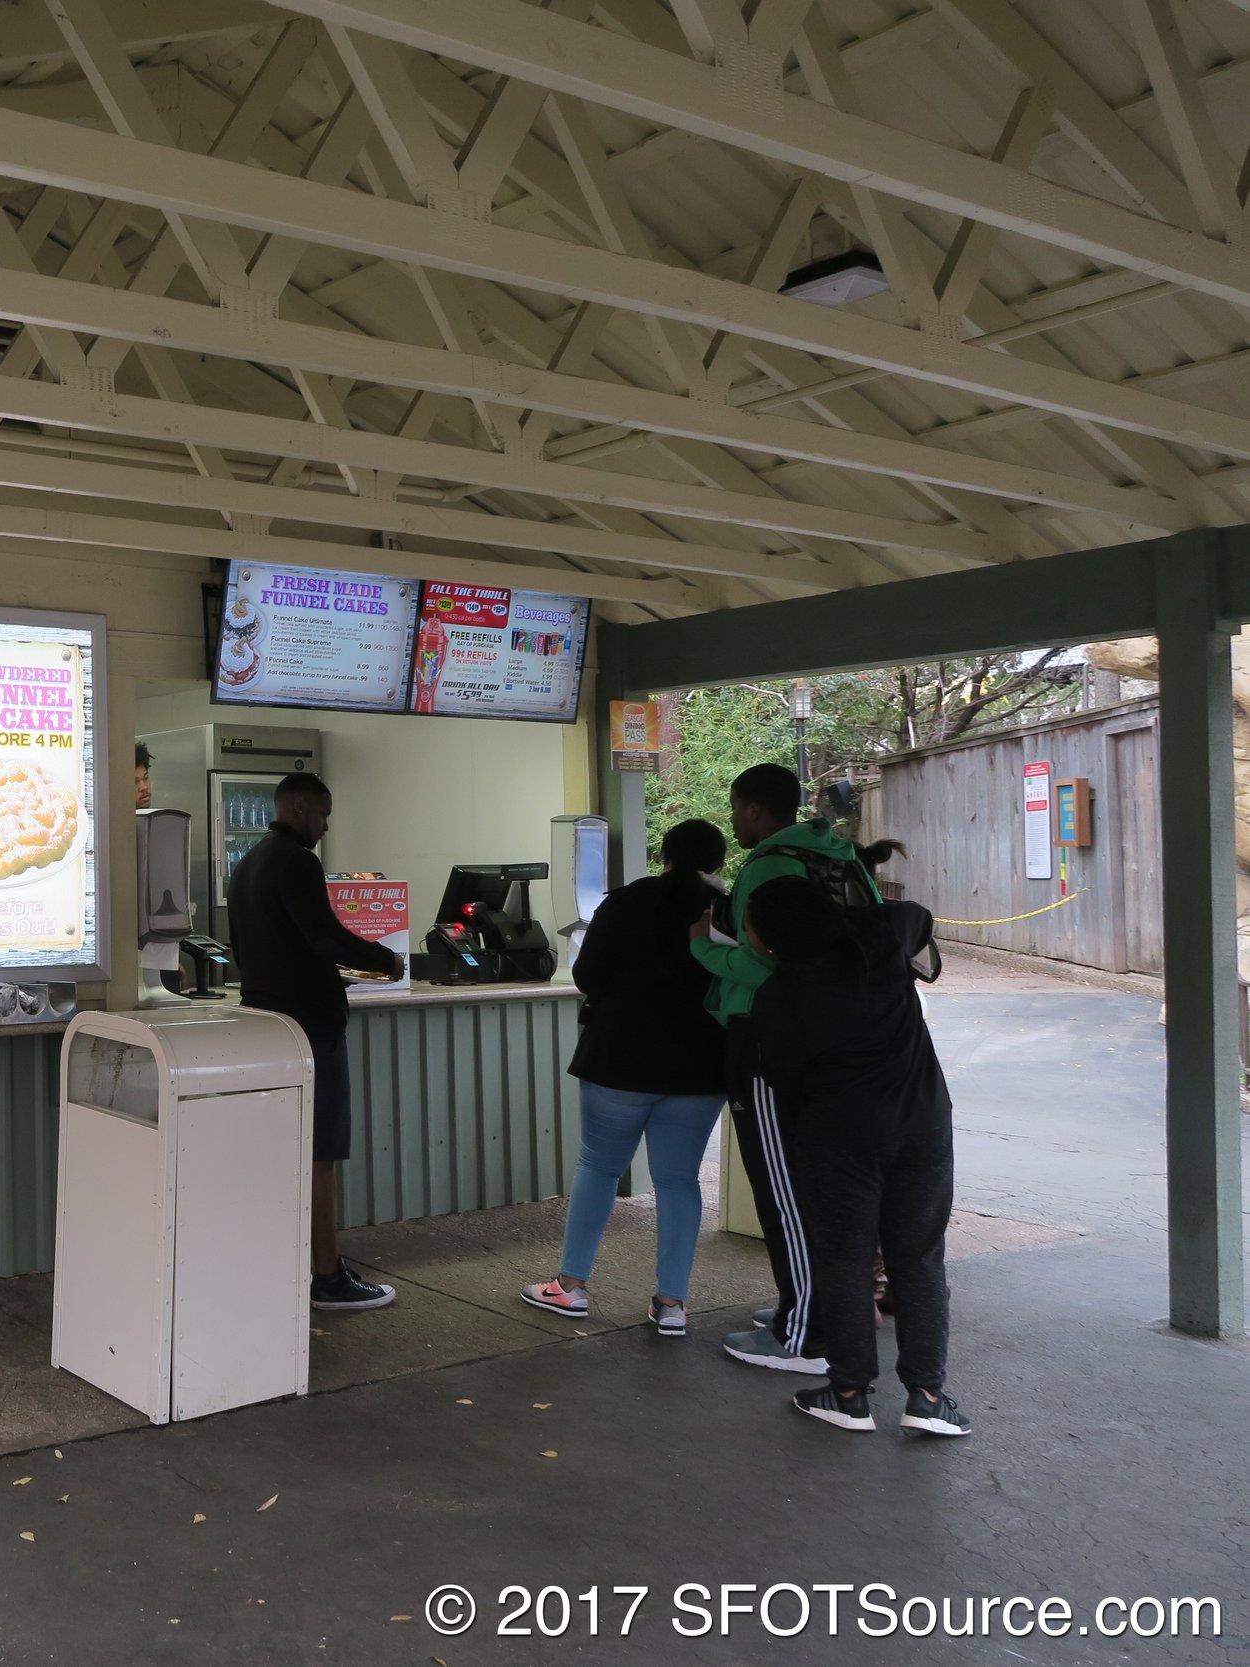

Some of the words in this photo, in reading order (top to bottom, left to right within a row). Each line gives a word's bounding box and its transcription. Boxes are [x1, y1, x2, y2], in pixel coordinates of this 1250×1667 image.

[272, 574, 330, 594] FRESH
[333, 581, 382, 599] MADE
[430, 584, 451, 594] FILL
[454, 587, 473, 597] THE
[475, 589, 508, 600] THRILL
[261, 590, 330, 610] FUNNEL
[334, 598, 389, 615] CAKES
[515, 604, 571, 626] Beverages
[451, 631, 470, 640] FREE
[472, 633, 502, 643] REFILLS
[467, 650, 498, 660] REFILLS
[0, 707, 72, 731] CAKE
[625, 722, 645, 730] DINING
[36, 734, 44, 747] 4
[50, 735, 72, 748] PM
[625, 730, 645, 742] PASS
[337, 889, 355, 900] FILL
[359, 888, 376, 899] THE
[377, 889, 406, 899] THRILL
[16, 918, 58, 935] Out!
